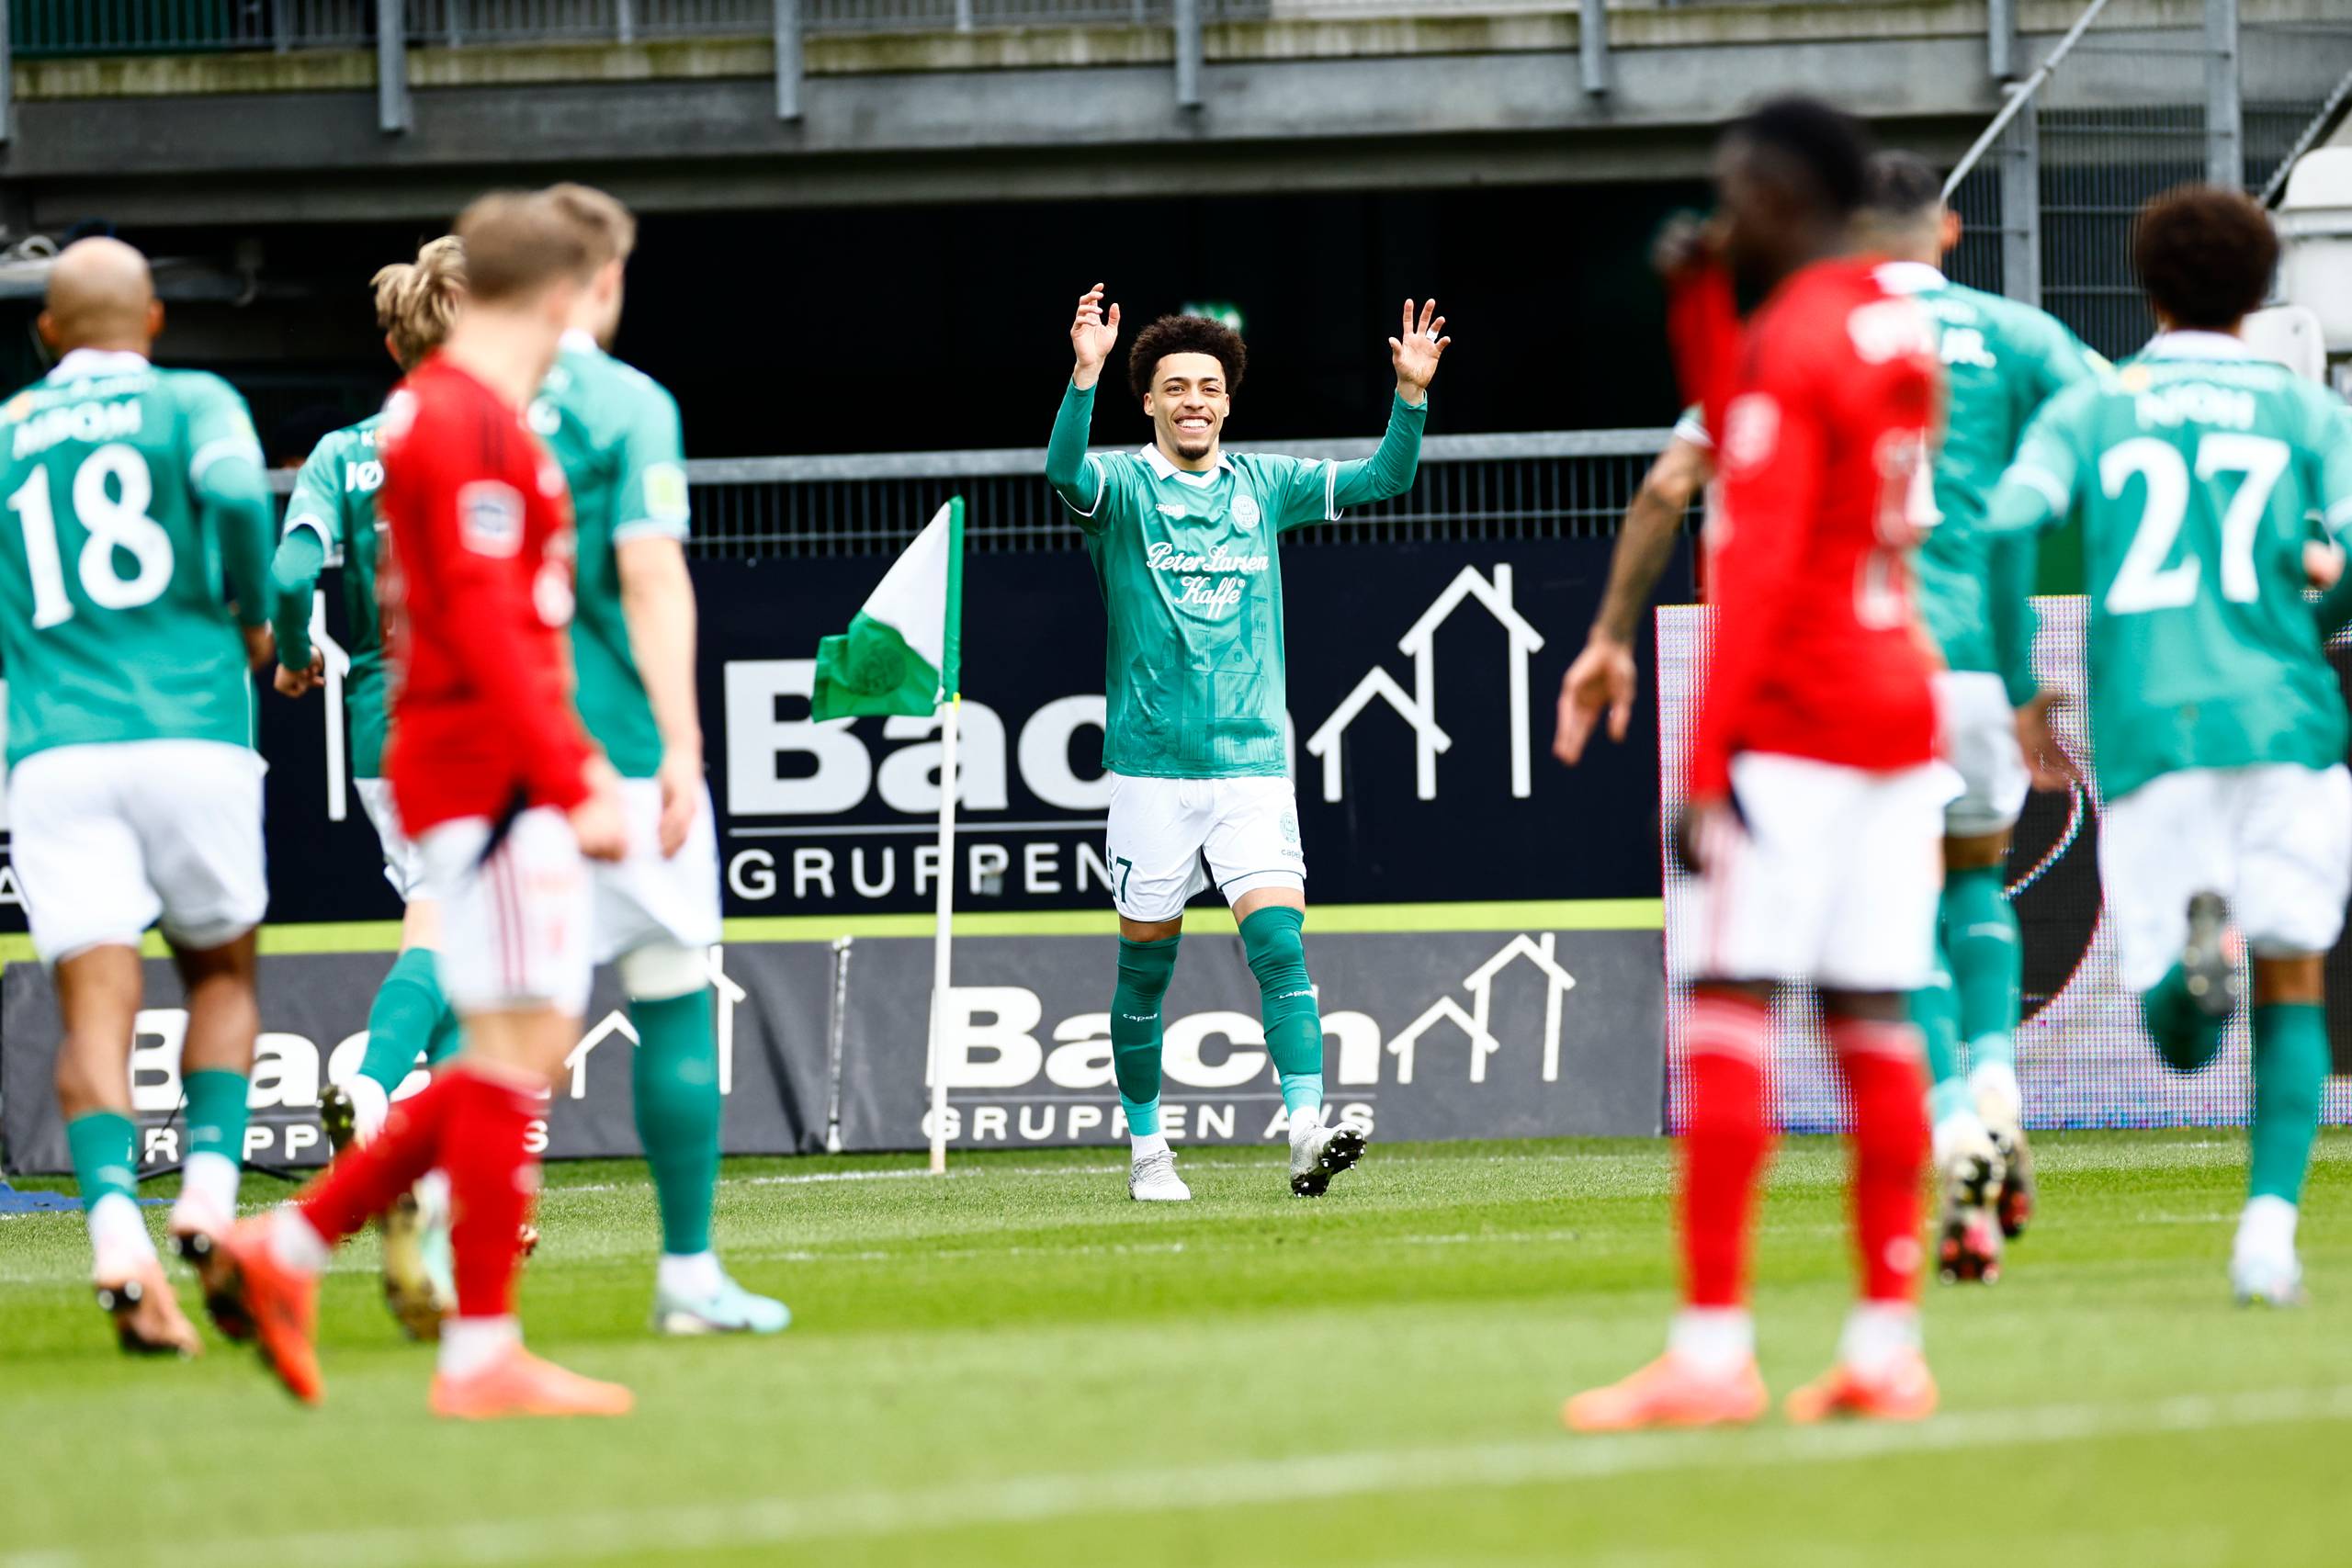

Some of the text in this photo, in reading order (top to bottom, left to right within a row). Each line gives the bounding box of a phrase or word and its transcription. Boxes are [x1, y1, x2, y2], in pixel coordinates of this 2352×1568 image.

[7, 443, 174, 629] 18
[1147, 542, 1269, 575] Peter Larsen
[2098, 434, 2291, 615] 27
[724, 659, 1296, 816] Bac
